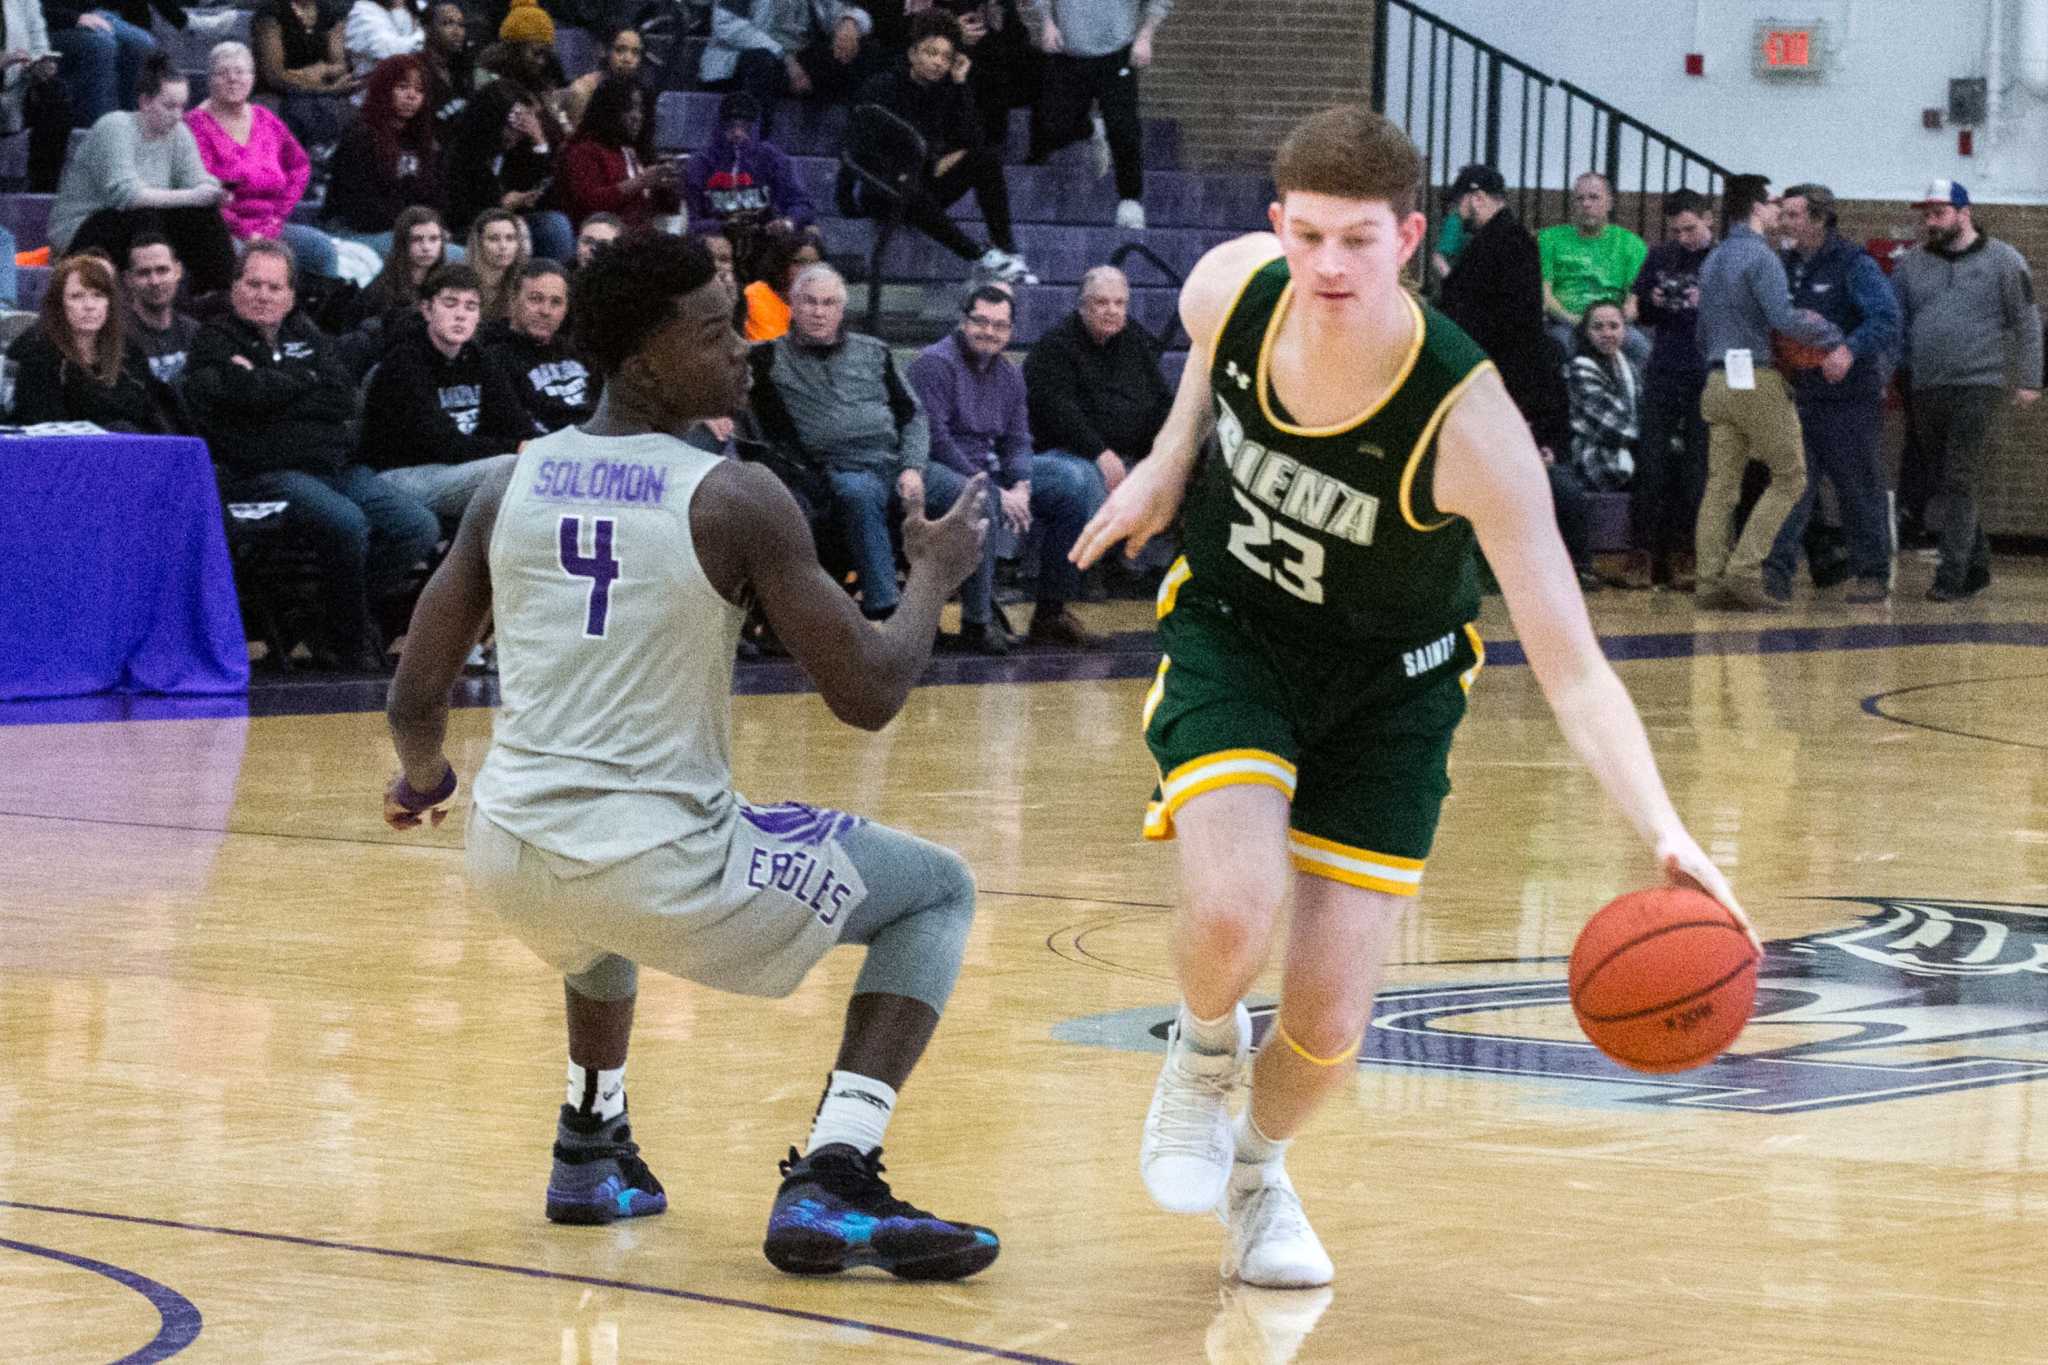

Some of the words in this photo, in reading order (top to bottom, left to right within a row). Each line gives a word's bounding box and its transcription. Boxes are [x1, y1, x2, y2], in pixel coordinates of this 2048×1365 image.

[533, 458, 669, 504] SOLOMON
[556, 513, 622, 639] 4
[1227, 486, 1325, 605] 23
[746, 846, 852, 926] EAGLES
